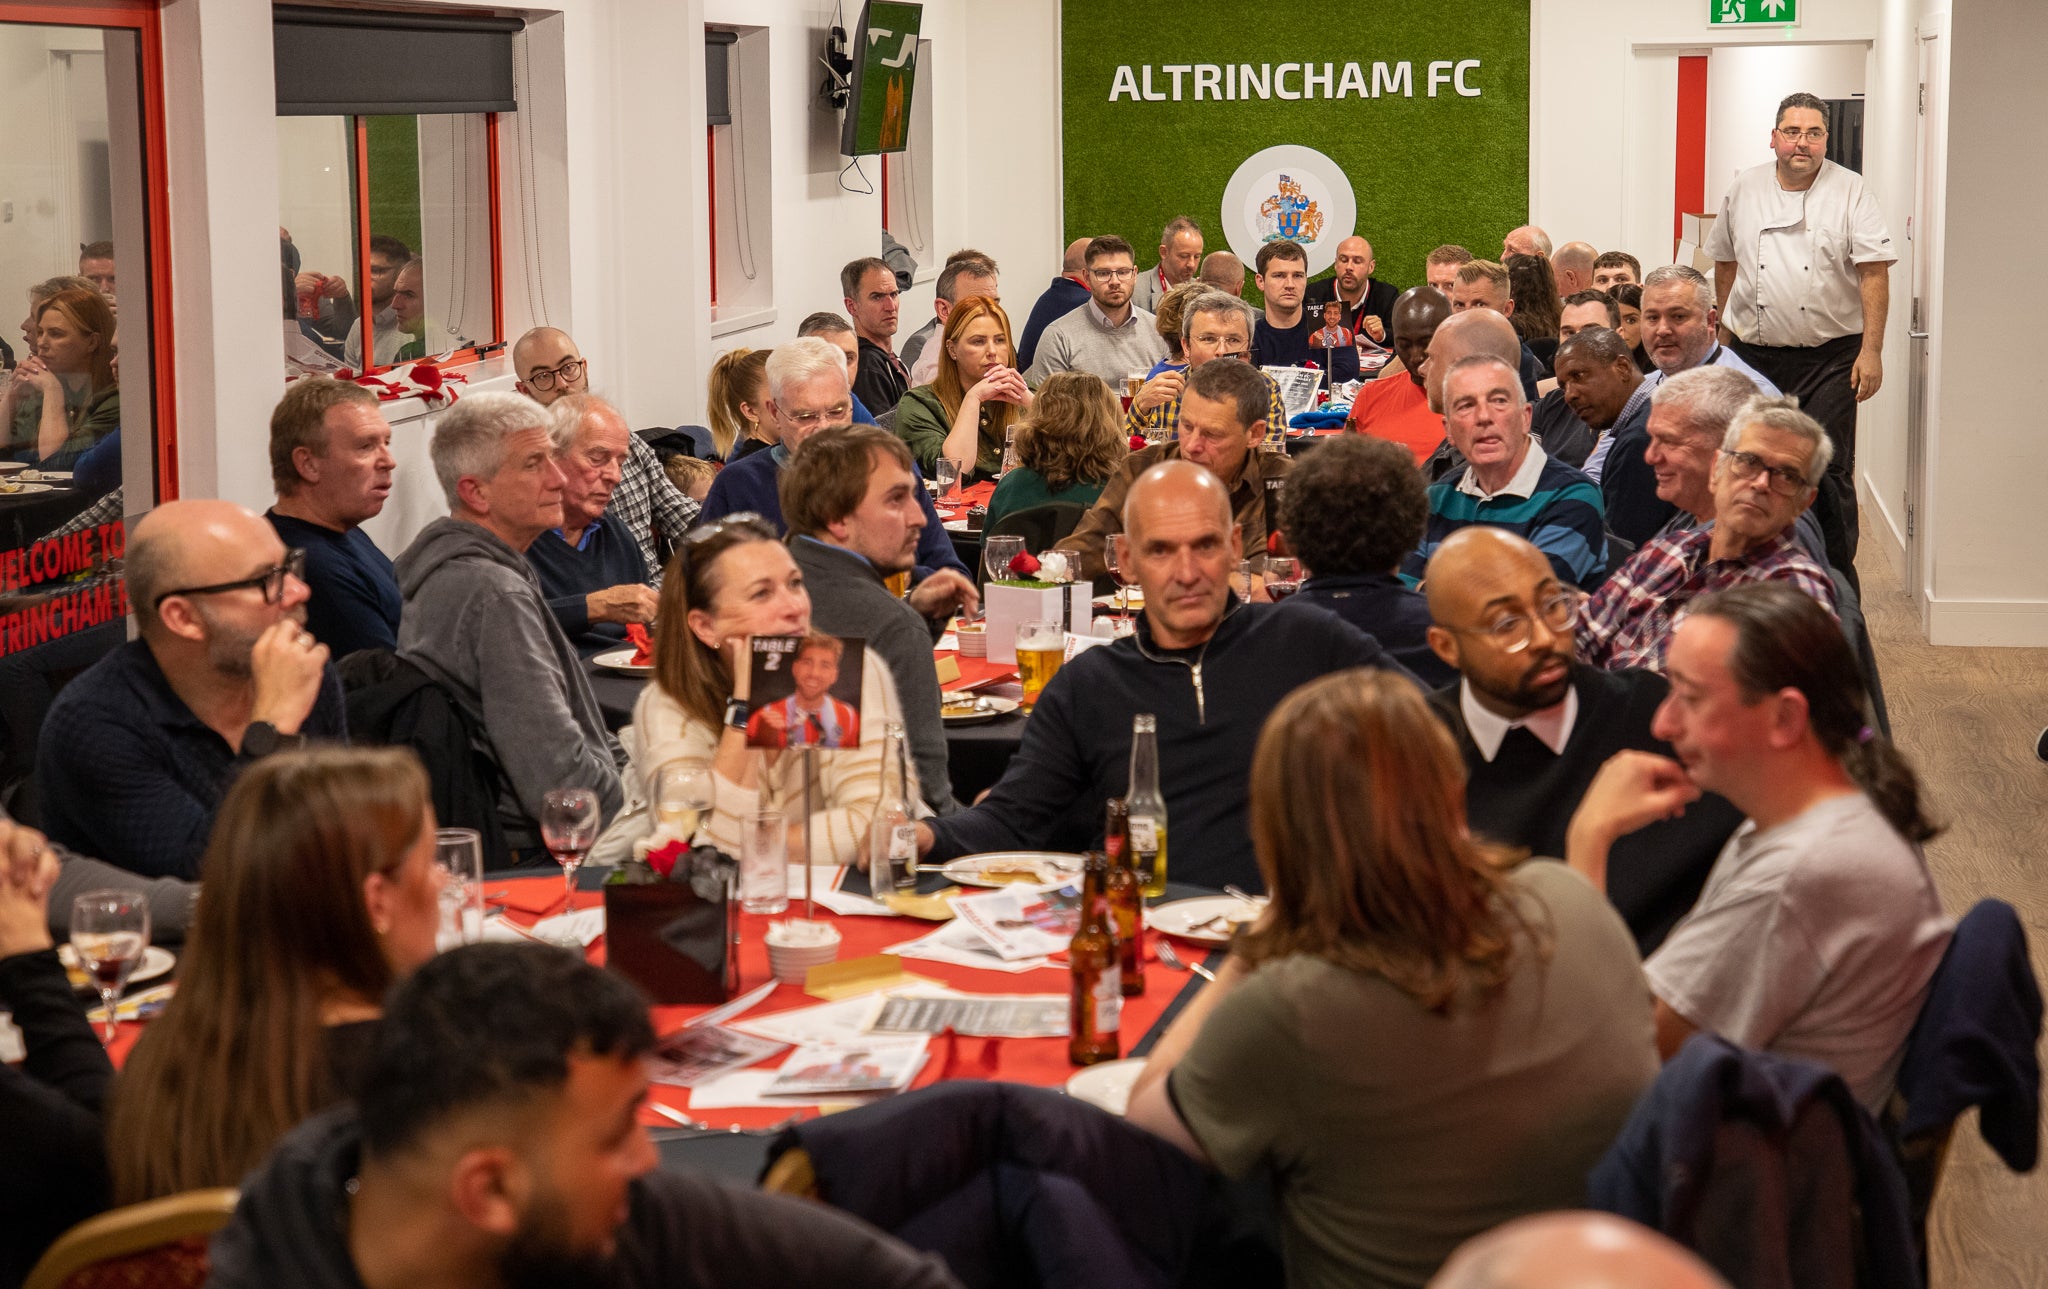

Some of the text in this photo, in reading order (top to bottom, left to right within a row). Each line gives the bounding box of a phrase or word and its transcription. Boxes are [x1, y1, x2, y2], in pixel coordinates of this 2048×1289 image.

[1108, 59, 1482, 102] ALTRINCHAM FC
[98, 520, 126, 563] TO
[753, 638, 798, 653] TABLE
[764, 653, 782, 670] 2
